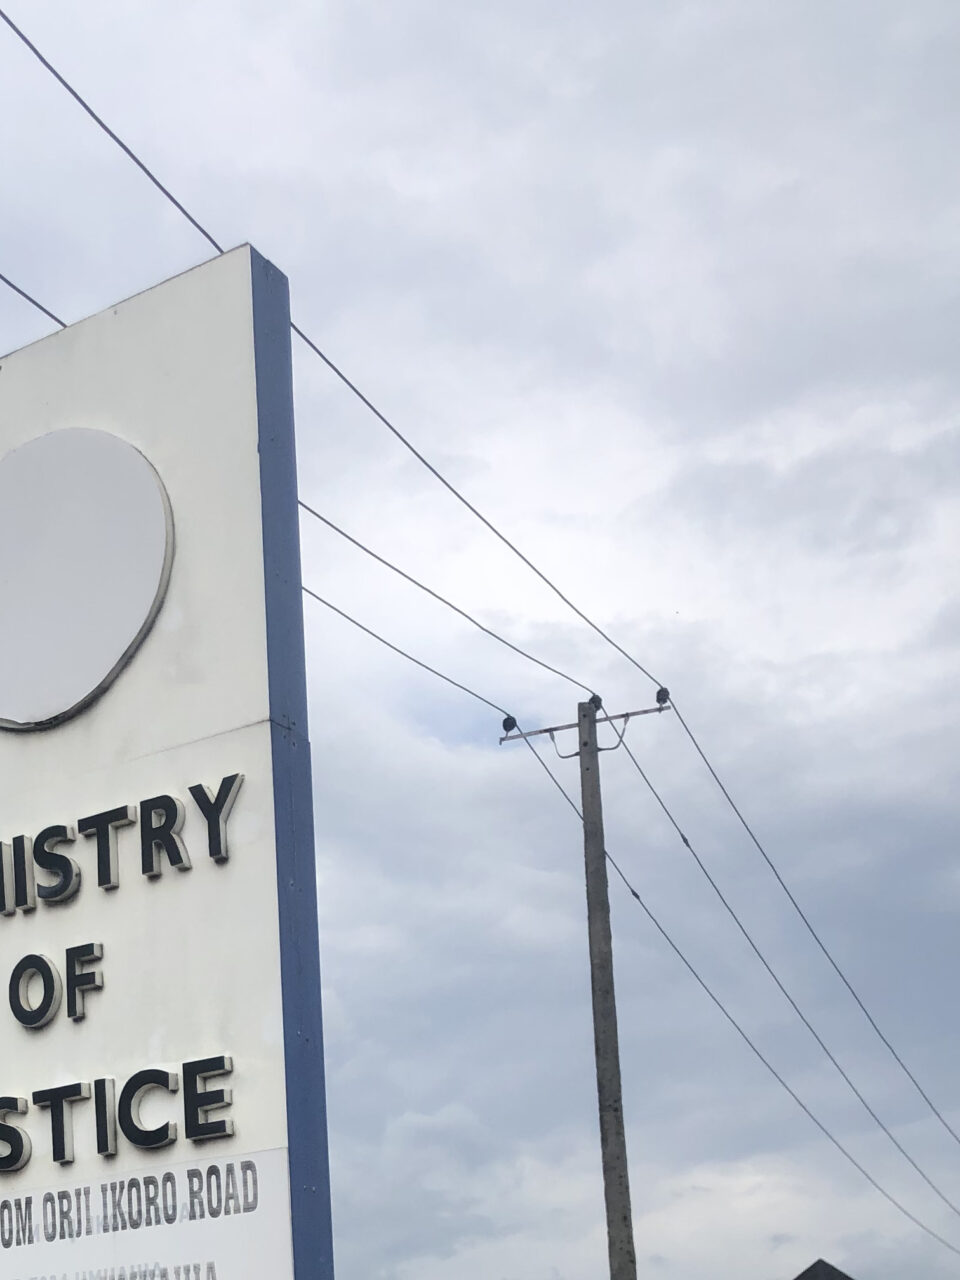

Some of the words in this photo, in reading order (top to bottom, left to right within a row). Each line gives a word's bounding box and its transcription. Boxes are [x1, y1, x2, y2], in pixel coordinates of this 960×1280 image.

[9, 942, 103, 1029] OF
[42, 1185, 92, 1242] ORJI
[100, 1171, 177, 1233] IKORO
[186, 1160, 258, 1221] ROAD
